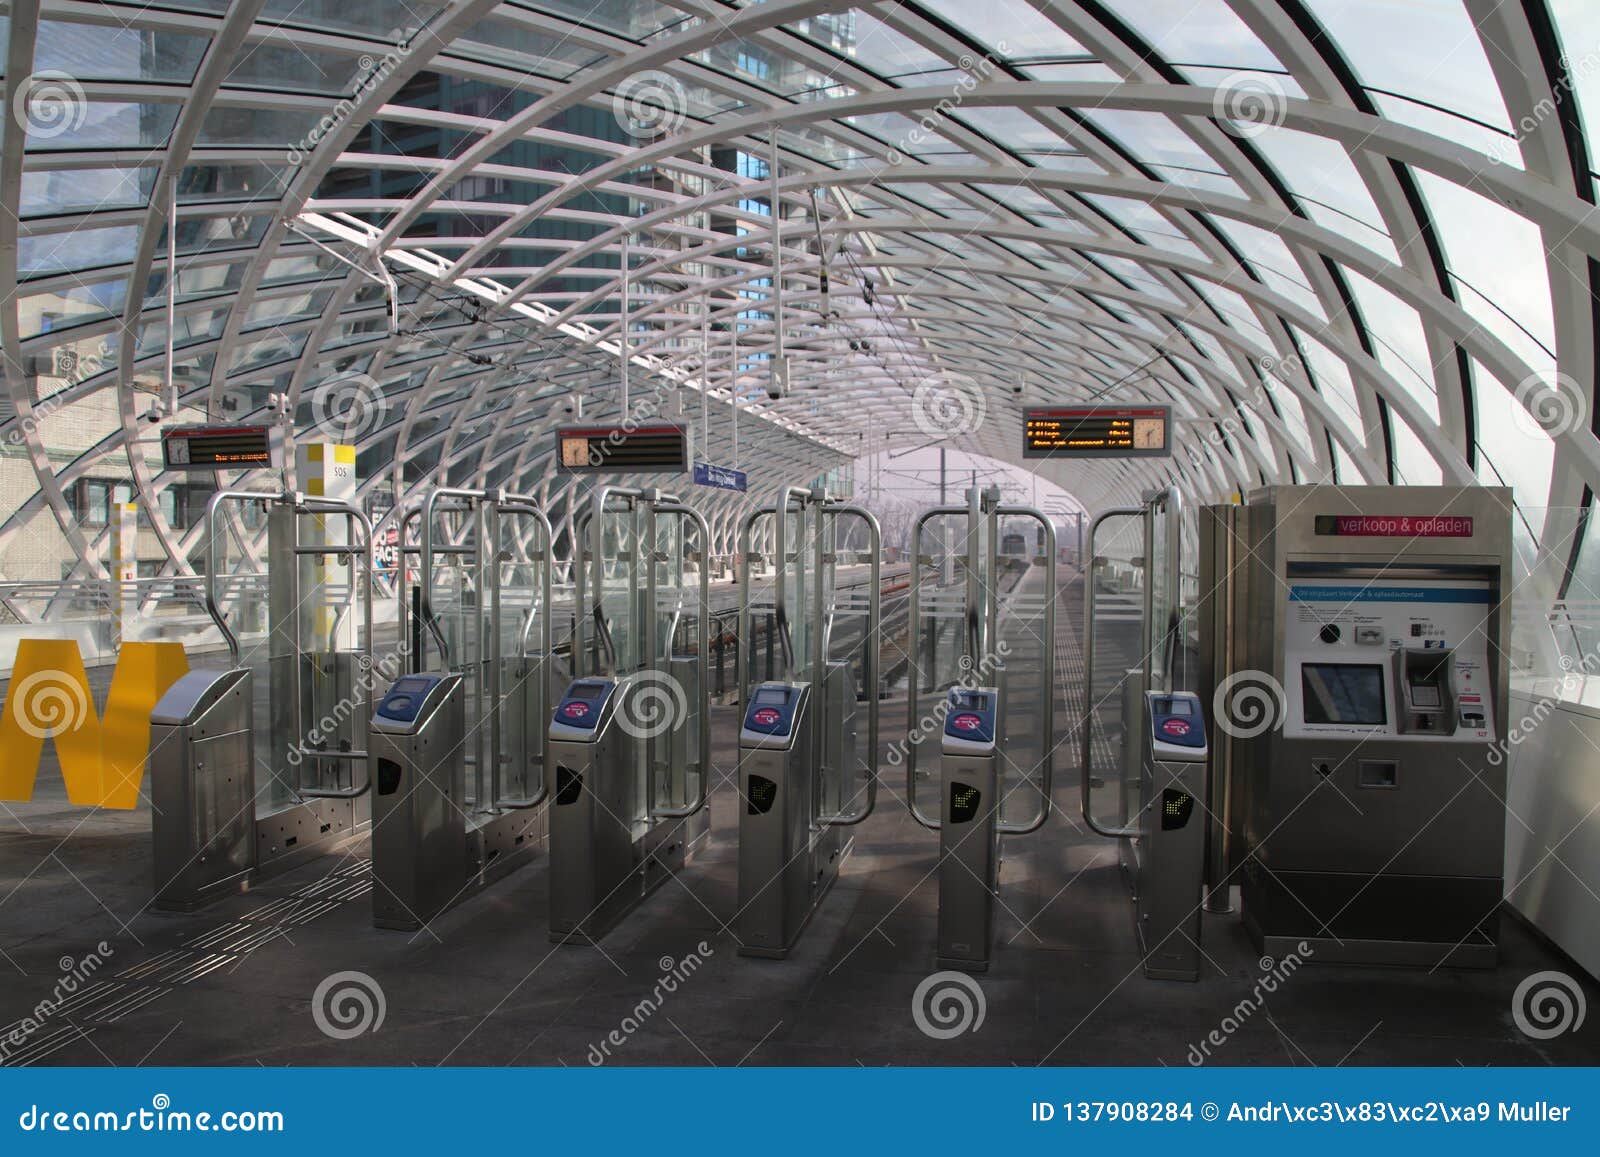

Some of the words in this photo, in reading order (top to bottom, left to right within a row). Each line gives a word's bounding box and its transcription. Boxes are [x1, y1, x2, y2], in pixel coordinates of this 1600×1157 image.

[334, 466, 347, 478] SOS
[1341, 518, 1397, 535] verkoop
[1401, 519, 1410, 533] &
[1415, 518, 1472, 535] opladen
